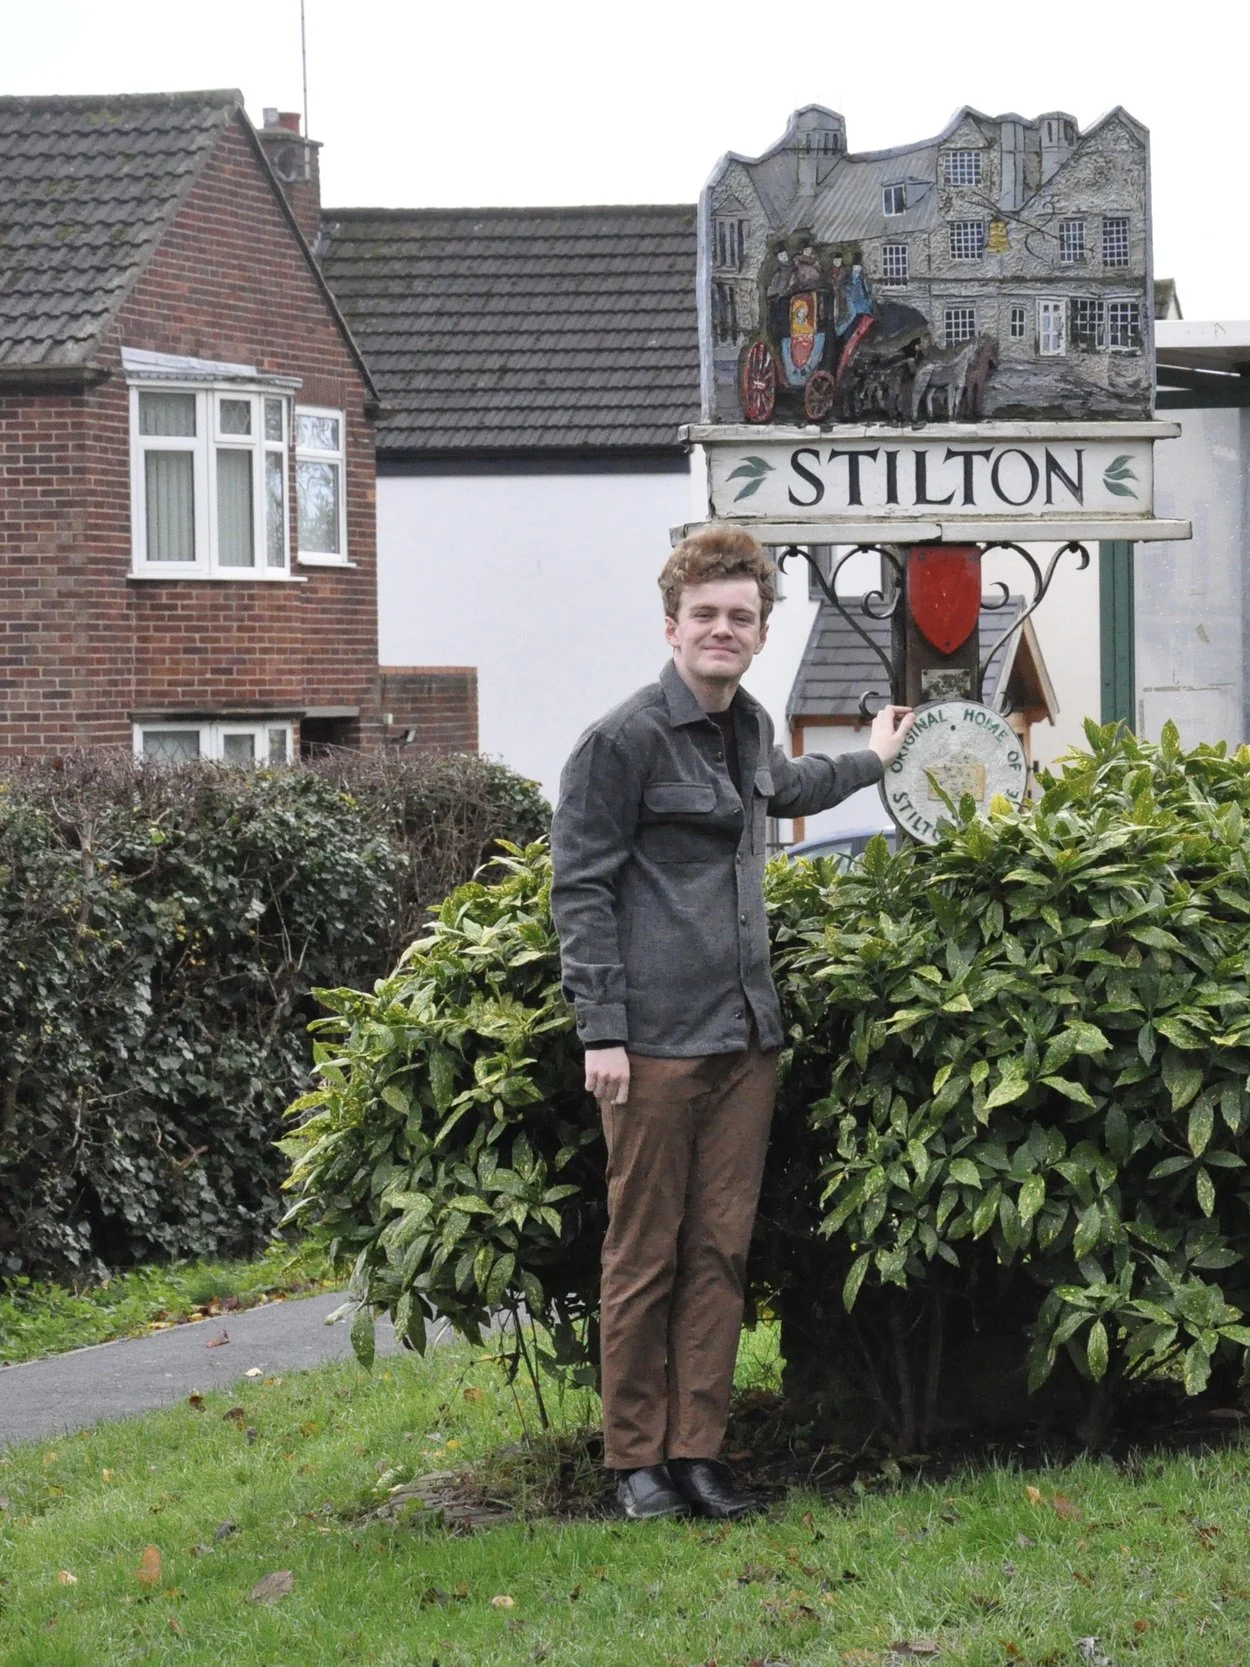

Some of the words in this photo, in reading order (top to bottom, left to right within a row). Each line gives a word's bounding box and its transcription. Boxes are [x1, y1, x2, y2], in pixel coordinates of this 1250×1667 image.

[787, 446, 1086, 507] STILTON
[963, 708, 1009, 743] HOME
[1007, 750, 1022, 772] OF
